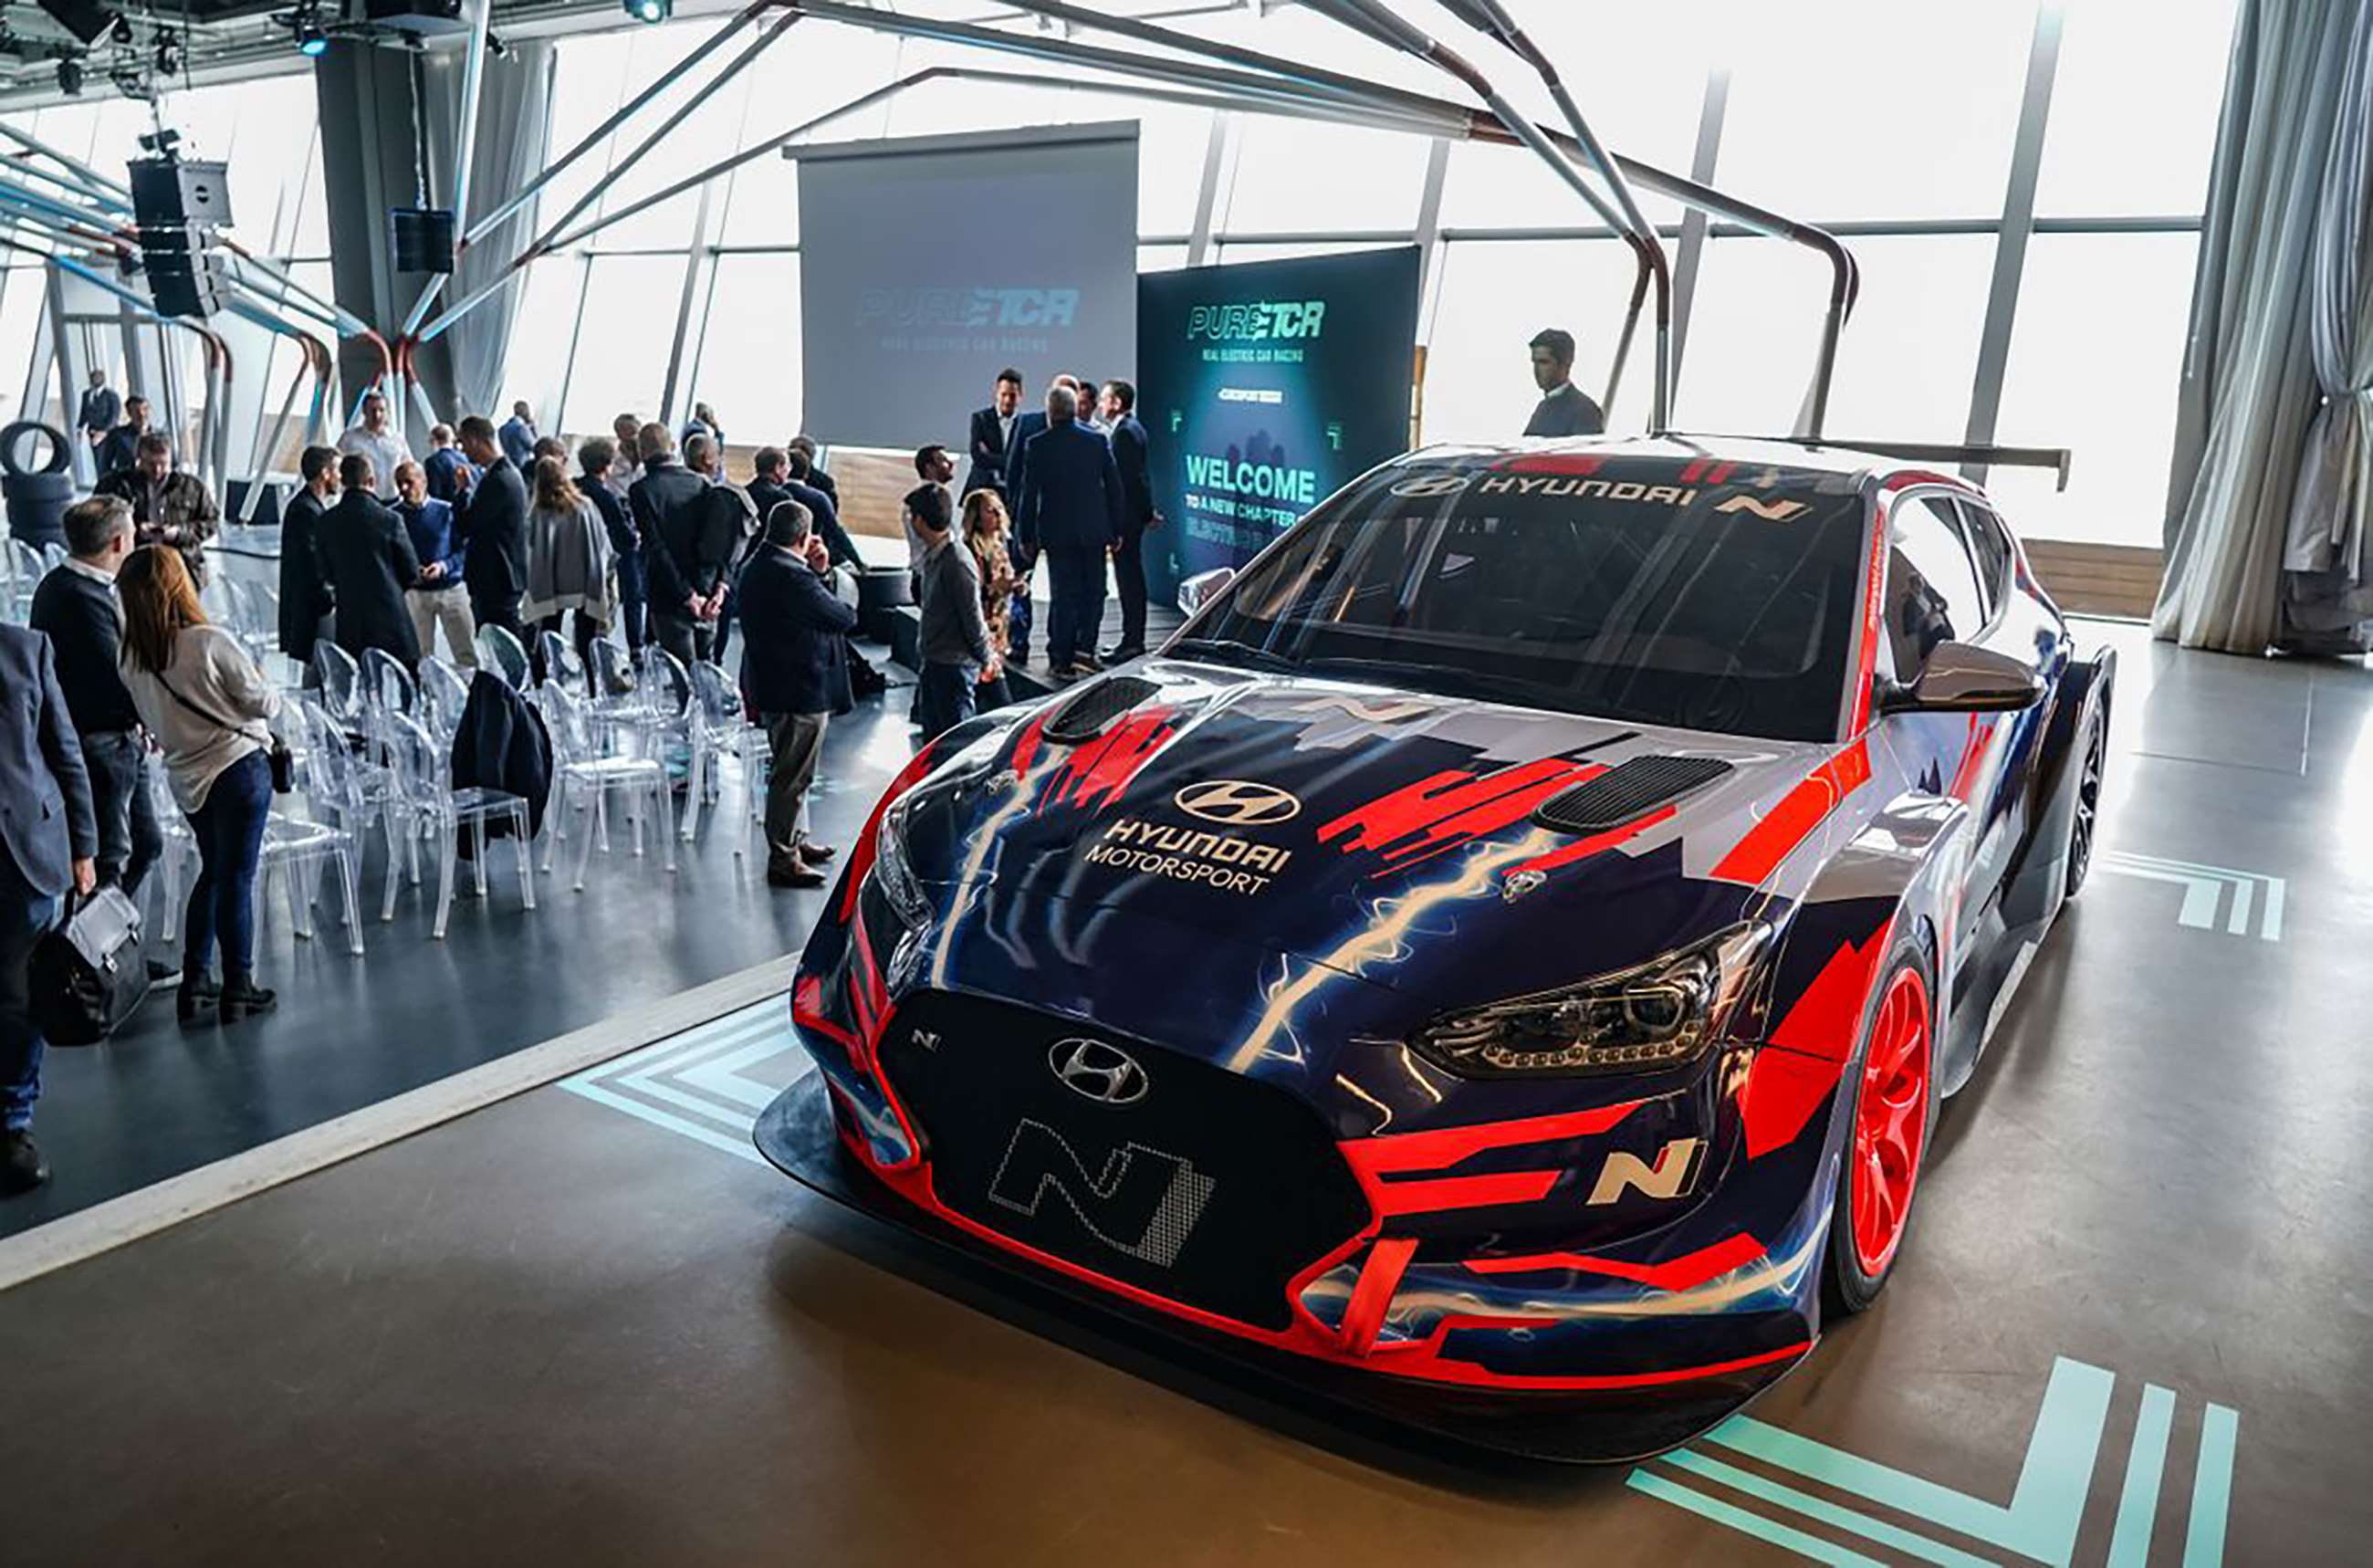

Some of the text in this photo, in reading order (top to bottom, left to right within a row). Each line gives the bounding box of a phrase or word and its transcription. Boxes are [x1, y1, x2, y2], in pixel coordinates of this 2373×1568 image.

[1186, 455, 1315, 504] WELCOME
[1480, 476, 1698, 506] HYUNDAI
[1209, 497, 1235, 517] NEW
[1084, 844, 1270, 895] MOTORSPORT
[1104, 819, 1291, 873] HYUNDAI
